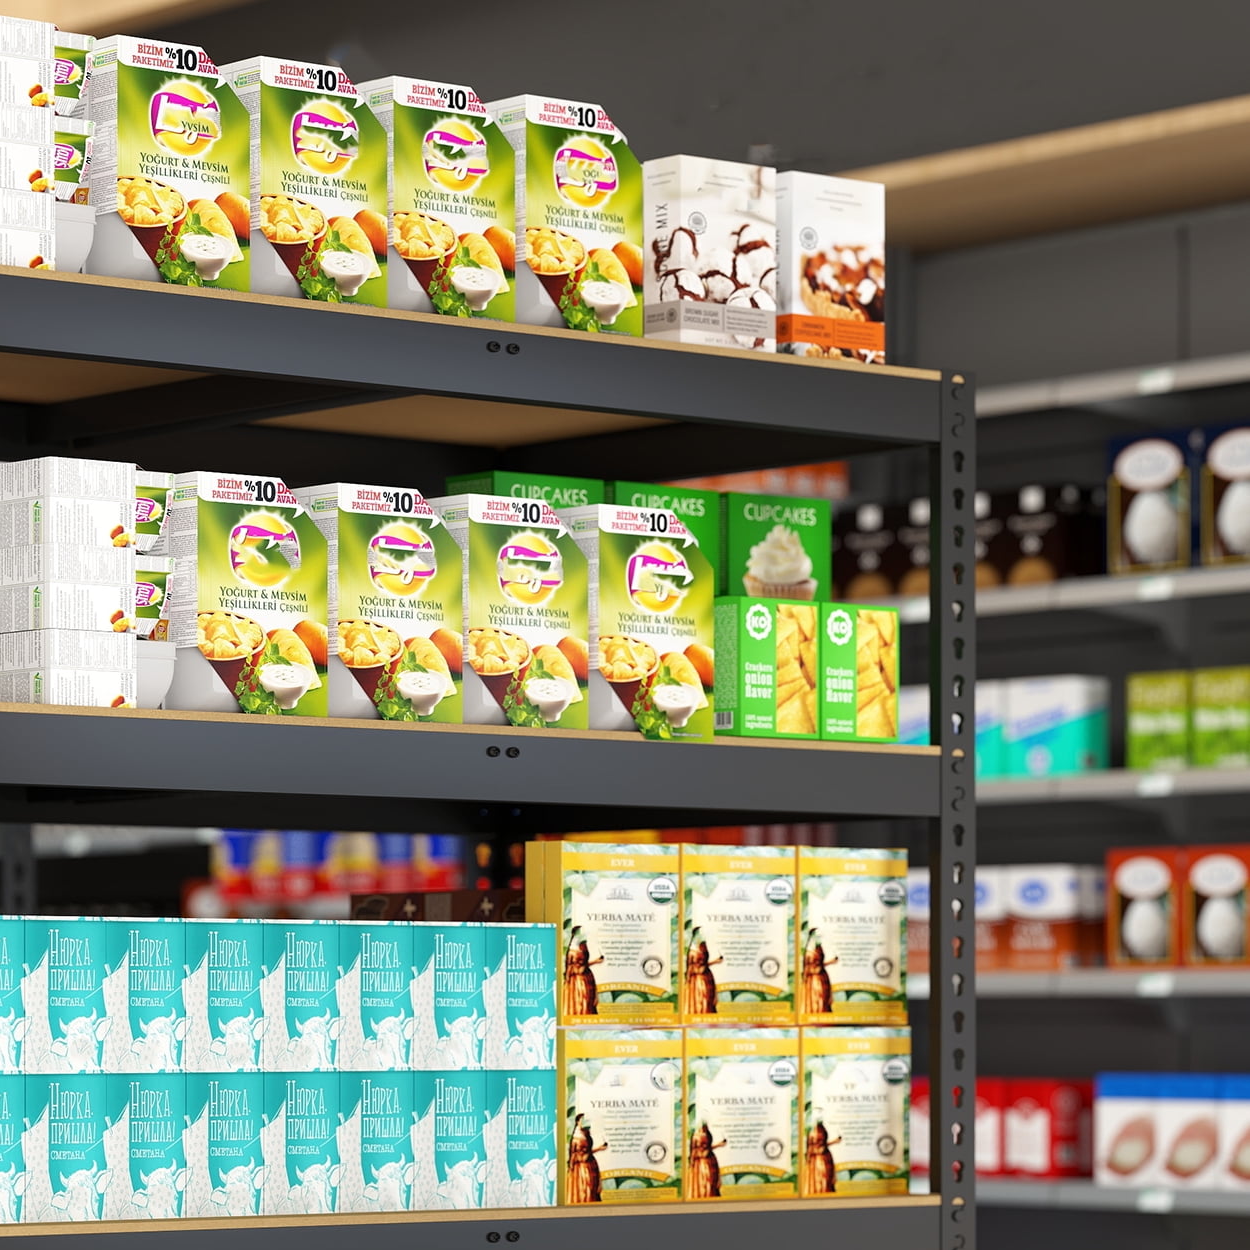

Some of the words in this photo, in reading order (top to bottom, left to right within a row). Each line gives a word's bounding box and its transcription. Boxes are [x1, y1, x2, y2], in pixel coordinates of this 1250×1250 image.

[137, 43, 164, 56] BİZİM
[132, 55, 174, 69] PAKETİMİZ
[280, 64, 304, 76] BİZİM
[274, 76, 315, 89] PAKETİMİZ
[140, 152, 178, 168] YOĞURT
[182, 160, 190, 168] &
[192, 158, 228, 173] MEVSİM
[138, 164, 198, 180] YEŞİLLİKLERİ
[282, 170, 320, 185] YOĞURT
[322, 177, 330, 186] &
[332, 178, 367, 191] MEVSİM
[281, 182, 338, 198] YEŞİLLİKLERİ
[218, 478, 242, 490] BİZİM
[212, 490, 253, 501] PAKETİMİZ
[357, 490, 381, 500] BİZİM
[352, 501, 391, 512] PAKETİMİZ
[744, 502, 817, 526] CUPCAKES
[220, 586, 257, 598] YOĞURT
[260, 590, 268, 599] &
[271, 590, 307, 602] MEVSİM
[219, 597, 277, 611] YEŞİLLİKLERİ
[360, 596, 395, 607] YOĞURT
[408, 600, 442, 610] MEVSİM
[745, 672, 772, 685] onion
[610, 858, 634, 868] EVER
[586, 913, 622, 922] YERBA
[707, 914, 742, 922] YERBA
[50, 995, 85, 1006] СМЕТАНА
[130, 997, 164, 1006] СМЕТАНА
[614, 1045, 638, 1054] EVER
[590, 1100, 626, 1109] YERBA
[50, 1149, 86, 1160] СМЕТАНА
